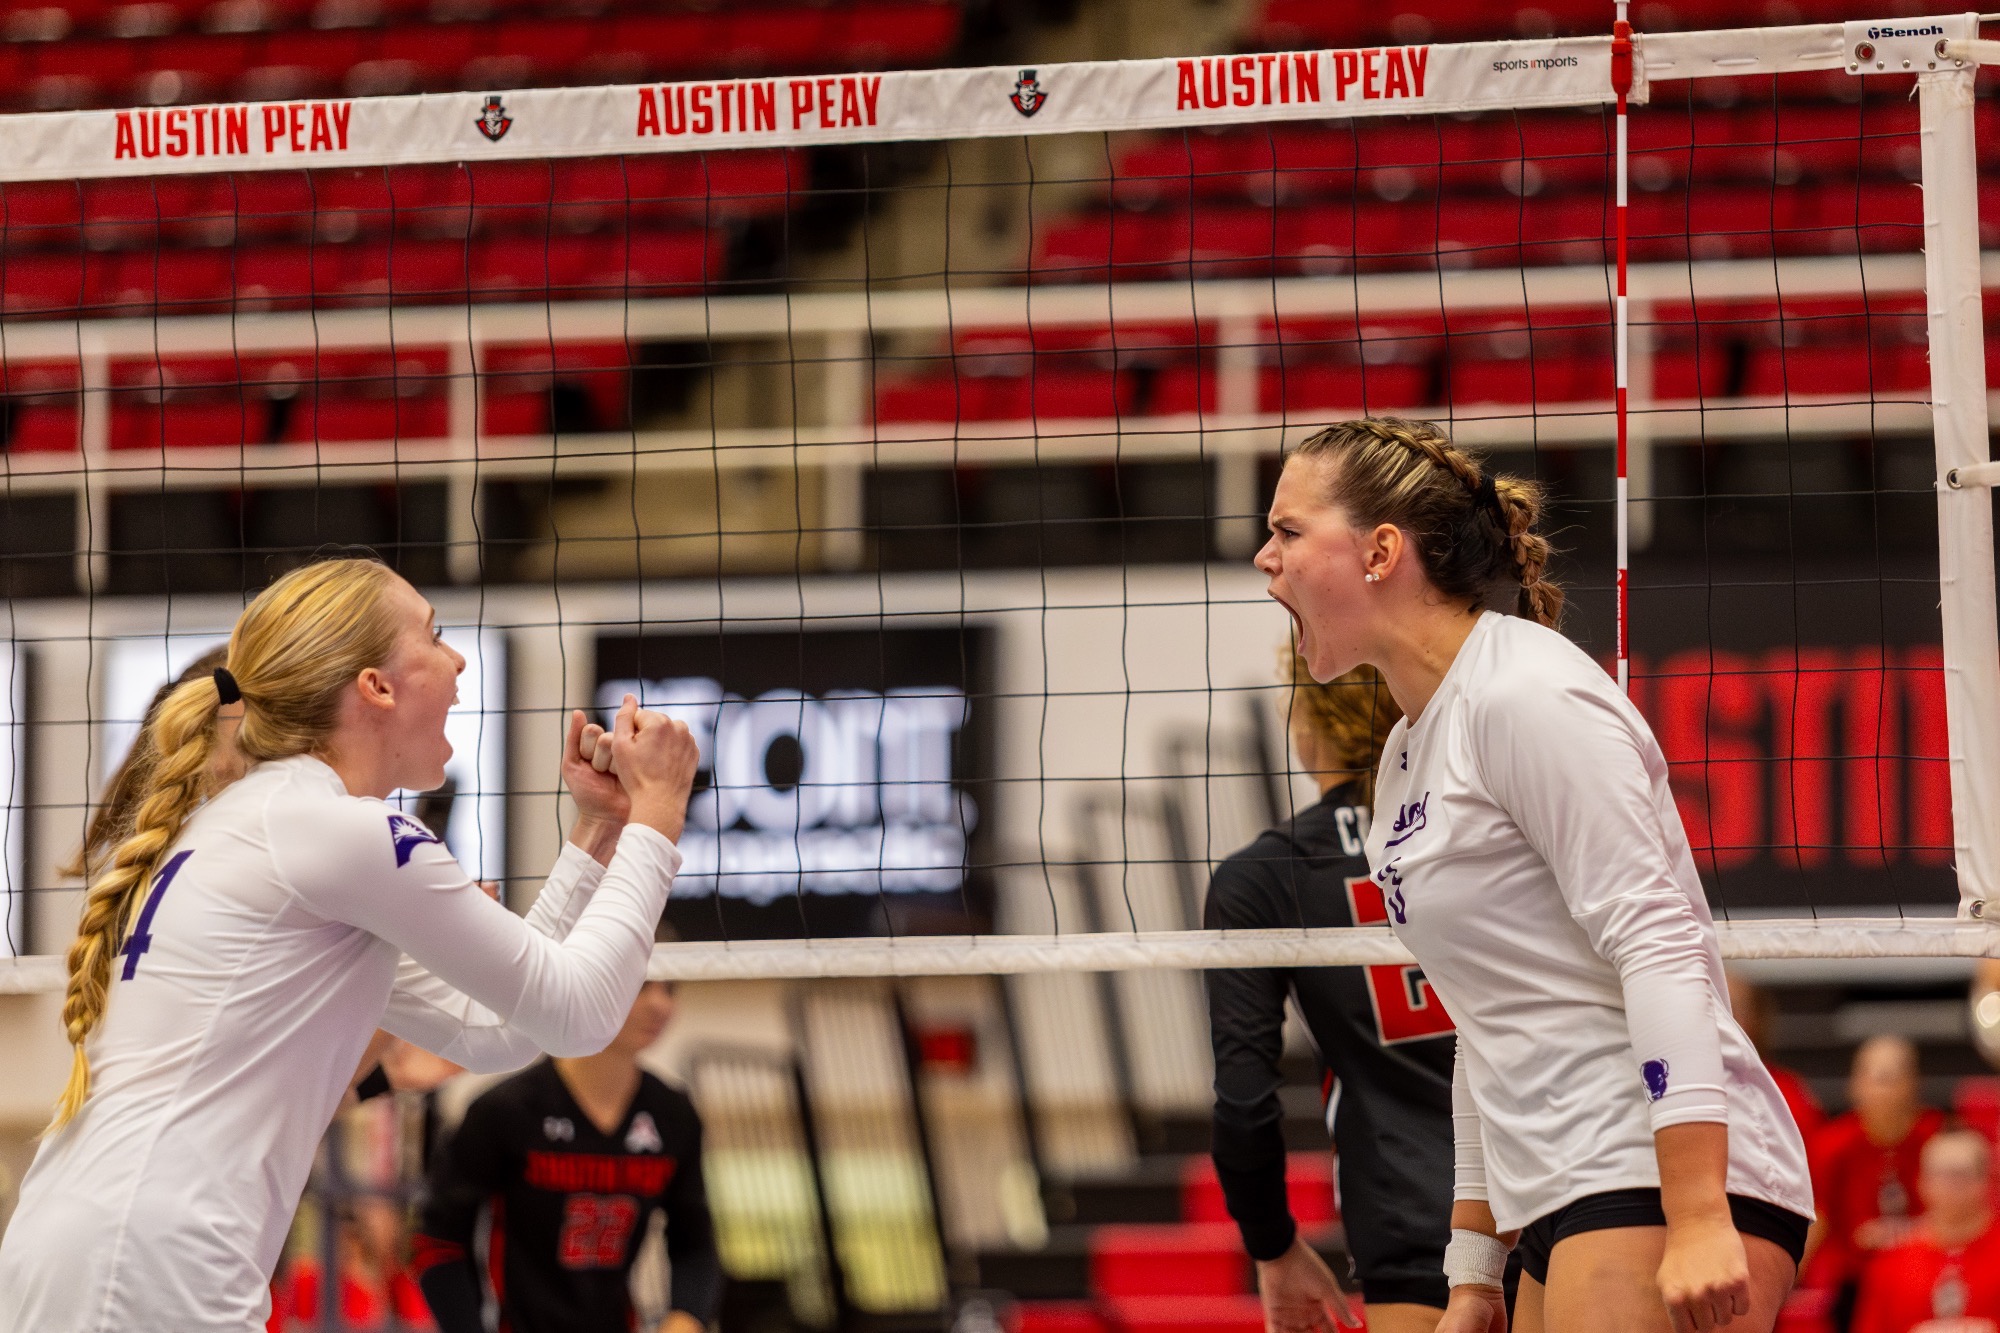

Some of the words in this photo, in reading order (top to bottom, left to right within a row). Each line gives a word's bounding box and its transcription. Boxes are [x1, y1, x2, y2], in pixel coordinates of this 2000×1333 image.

[1881, 25, 1944, 38] Senoh
[1177, 52, 1320, 110] AUSTIN
[1332, 46, 1428, 101] PEAY
[1493, 59, 1529, 73] sports
[115, 106, 248, 159] AUSTIN
[262, 101, 351, 153] PEAY
[637, 82, 776, 136] AUSTIN
[789, 76, 881, 129] PEAY
